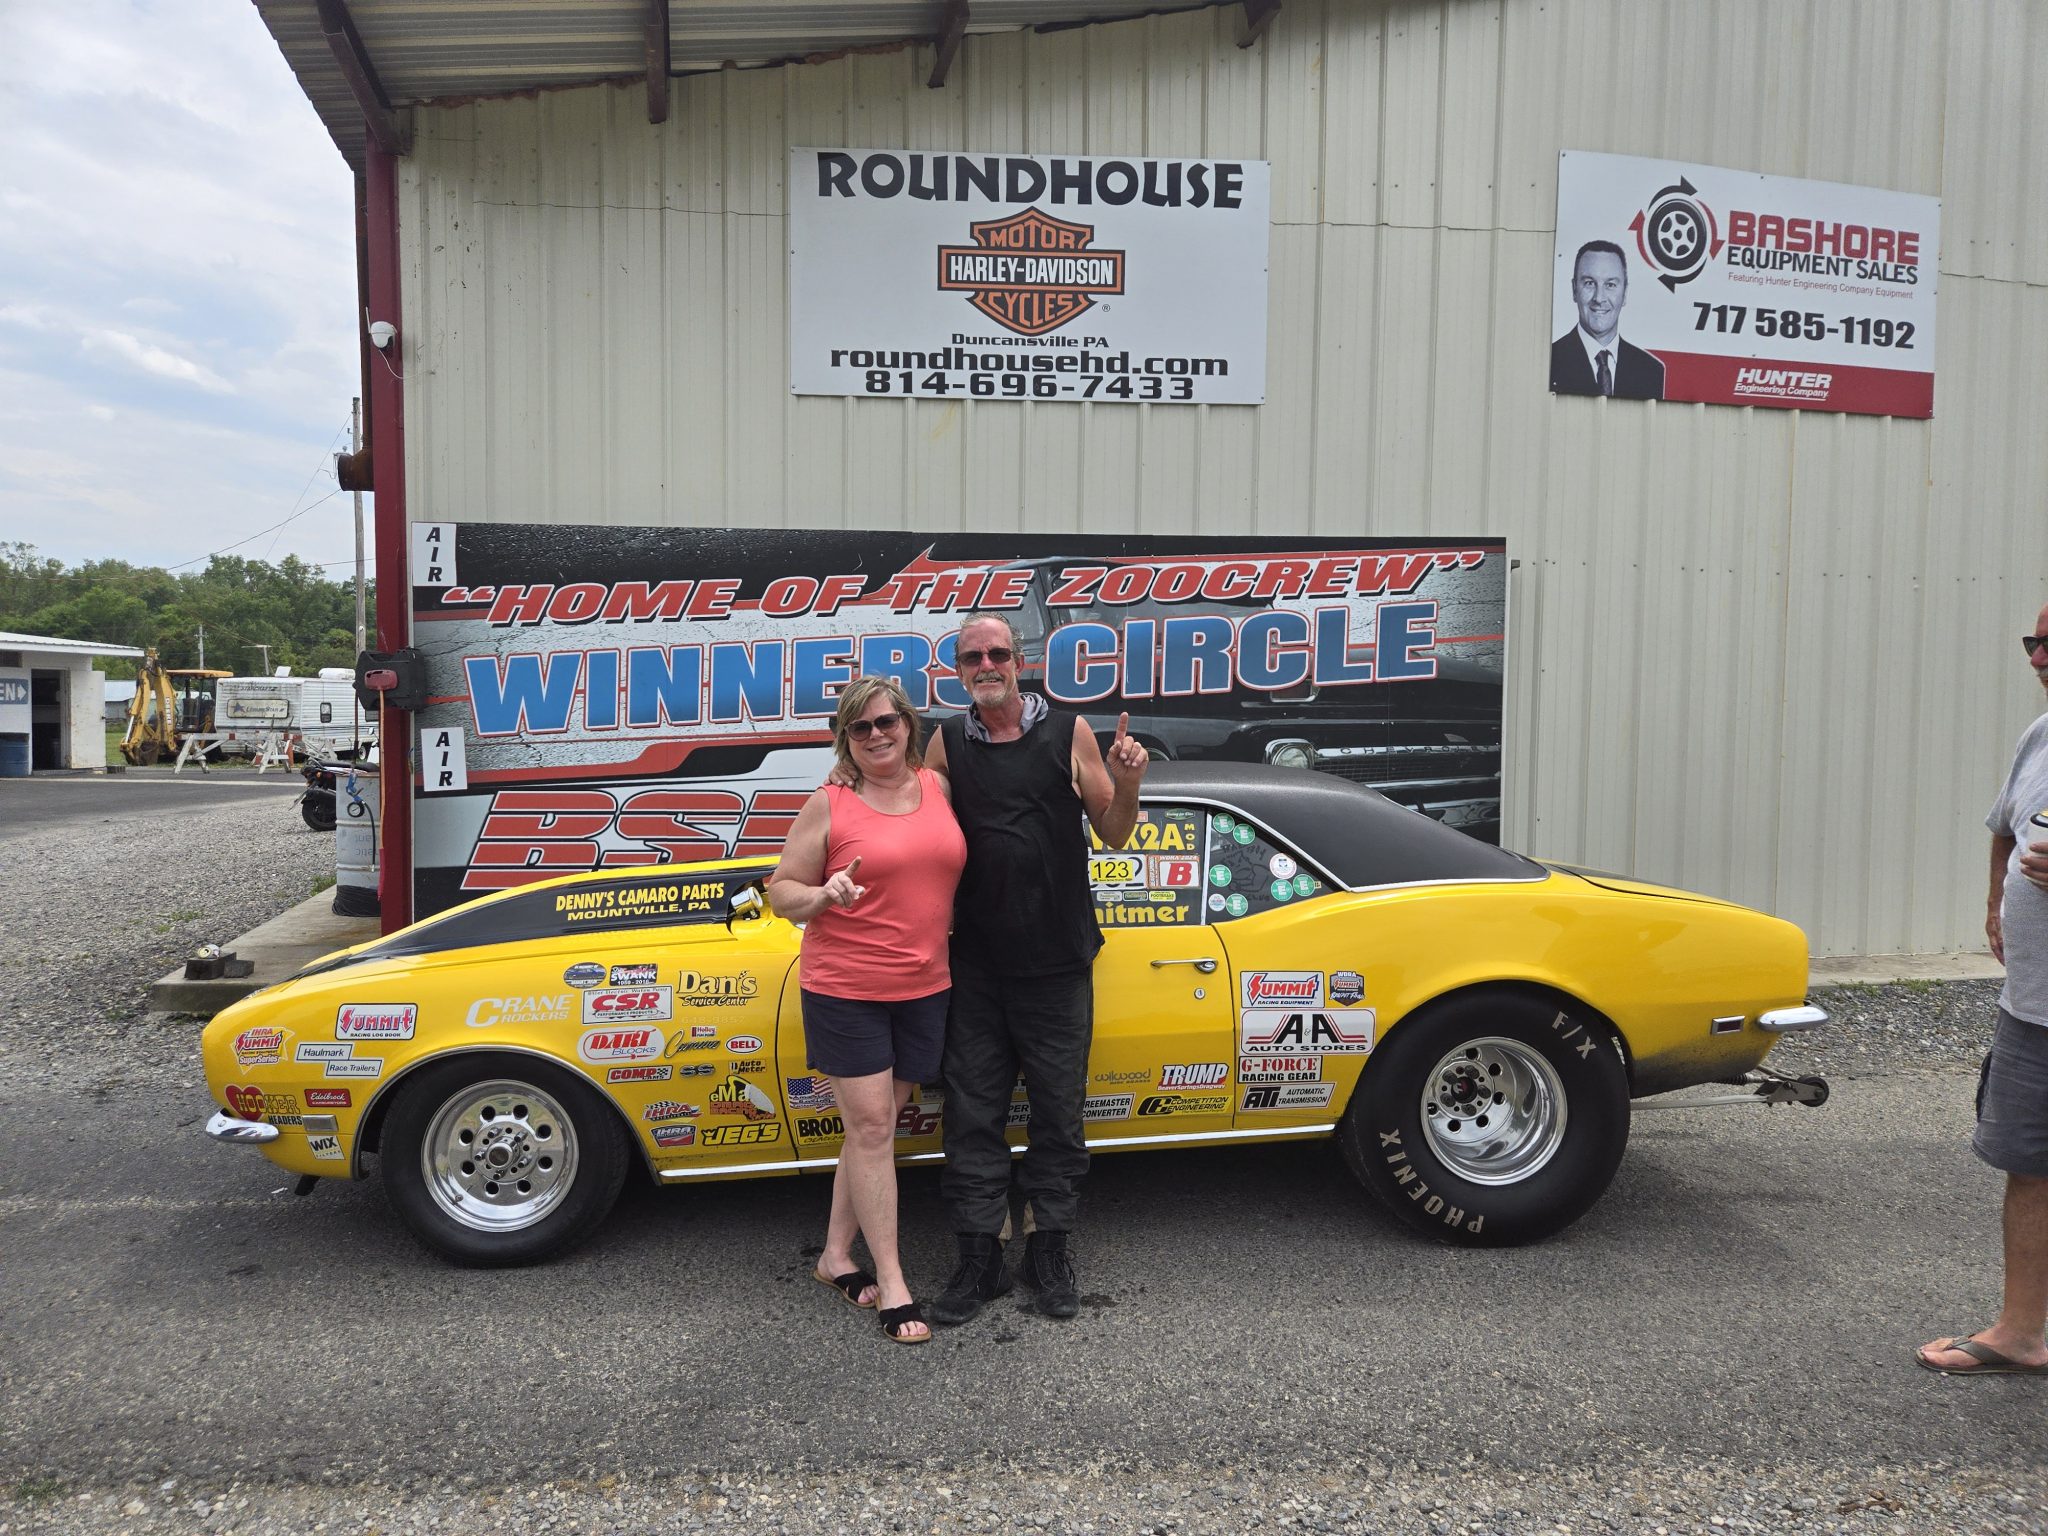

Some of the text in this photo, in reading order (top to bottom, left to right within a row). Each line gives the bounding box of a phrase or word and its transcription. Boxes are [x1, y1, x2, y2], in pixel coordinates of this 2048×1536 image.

[817, 152, 1243, 209] ROUNDHOUSE
[989, 220, 1075, 250] MOTOR
[1727, 209, 1920, 266] BASHORE
[950, 255, 1114, 286] HARLEY-DAVIDSON
[1727, 245, 1918, 285] EQUIPMENT SALES
[1728, 271, 1913, 300] Featuring Hunter Engineering Company Equipment
[988, 292, 1074, 327] CYCLES
[1693, 301, 1915, 349] 717 585-1192
[951, 333, 1110, 348] Duncansville PA
[830, 347, 1229, 376] roundhousehd.com
[865, 370, 1194, 400] 814-696-7433
[1736, 368, 1832, 389] HUNTER
[1734, 383, 1829, 399] Engineering Company
[758, 574, 868, 618] OF
[889, 570, 1035, 614] THE
[1043, 600, 1439, 703] CIRCLE
[1094, 861, 1129, 878] 123
[1166, 862, 1193, 885] B
[556, 882, 725, 911] DENNY'S CAMARO PARTS
[688, 901, 711, 911] PA
[611, 971, 657, 982] SWANK
[676, 969, 758, 995] Dan's
[592, 992, 660, 1011] CSR
[681, 995, 749, 1007] Service Center
[465, 993, 575, 1028] CRANE
[501, 1011, 569, 1025] ROCKERS
[590, 1030, 652, 1050] DART
[1551, 1011, 1598, 1059] F/X
[303, 1048, 345, 1057] Haulmark
[612, 1046, 657, 1056] BLOCKS
[730, 1040, 758, 1049] BELL
[1247, 1044, 1366, 1052] AUTO STORES
[330, 1064, 348, 1072] Race
[1241, 1057, 1317, 1072] G-FORCE
[610, 1068, 657, 1081] COMP
[1161, 1063, 1230, 1086] TRUMP
[1242, 1072, 1317, 1081] RACING GEAR
[310, 1091, 346, 1101] Edelbrock
[1278, 1095, 1328, 1105] TRANSMISSION
[1287, 1087, 1325, 1095] AUTOMATIC
[236, 1091, 301, 1115] HOOKER
[1168, 1103, 1225, 1112] ENGINEERING
[1170, 1096, 1229, 1106] COMPETITION
[646, 1103, 692, 1118] IHRA
[268, 1114, 303, 1126] HEADERS
[310, 1136, 338, 1151] WIX
[1379, 1128, 1485, 1234] PHOENIX
